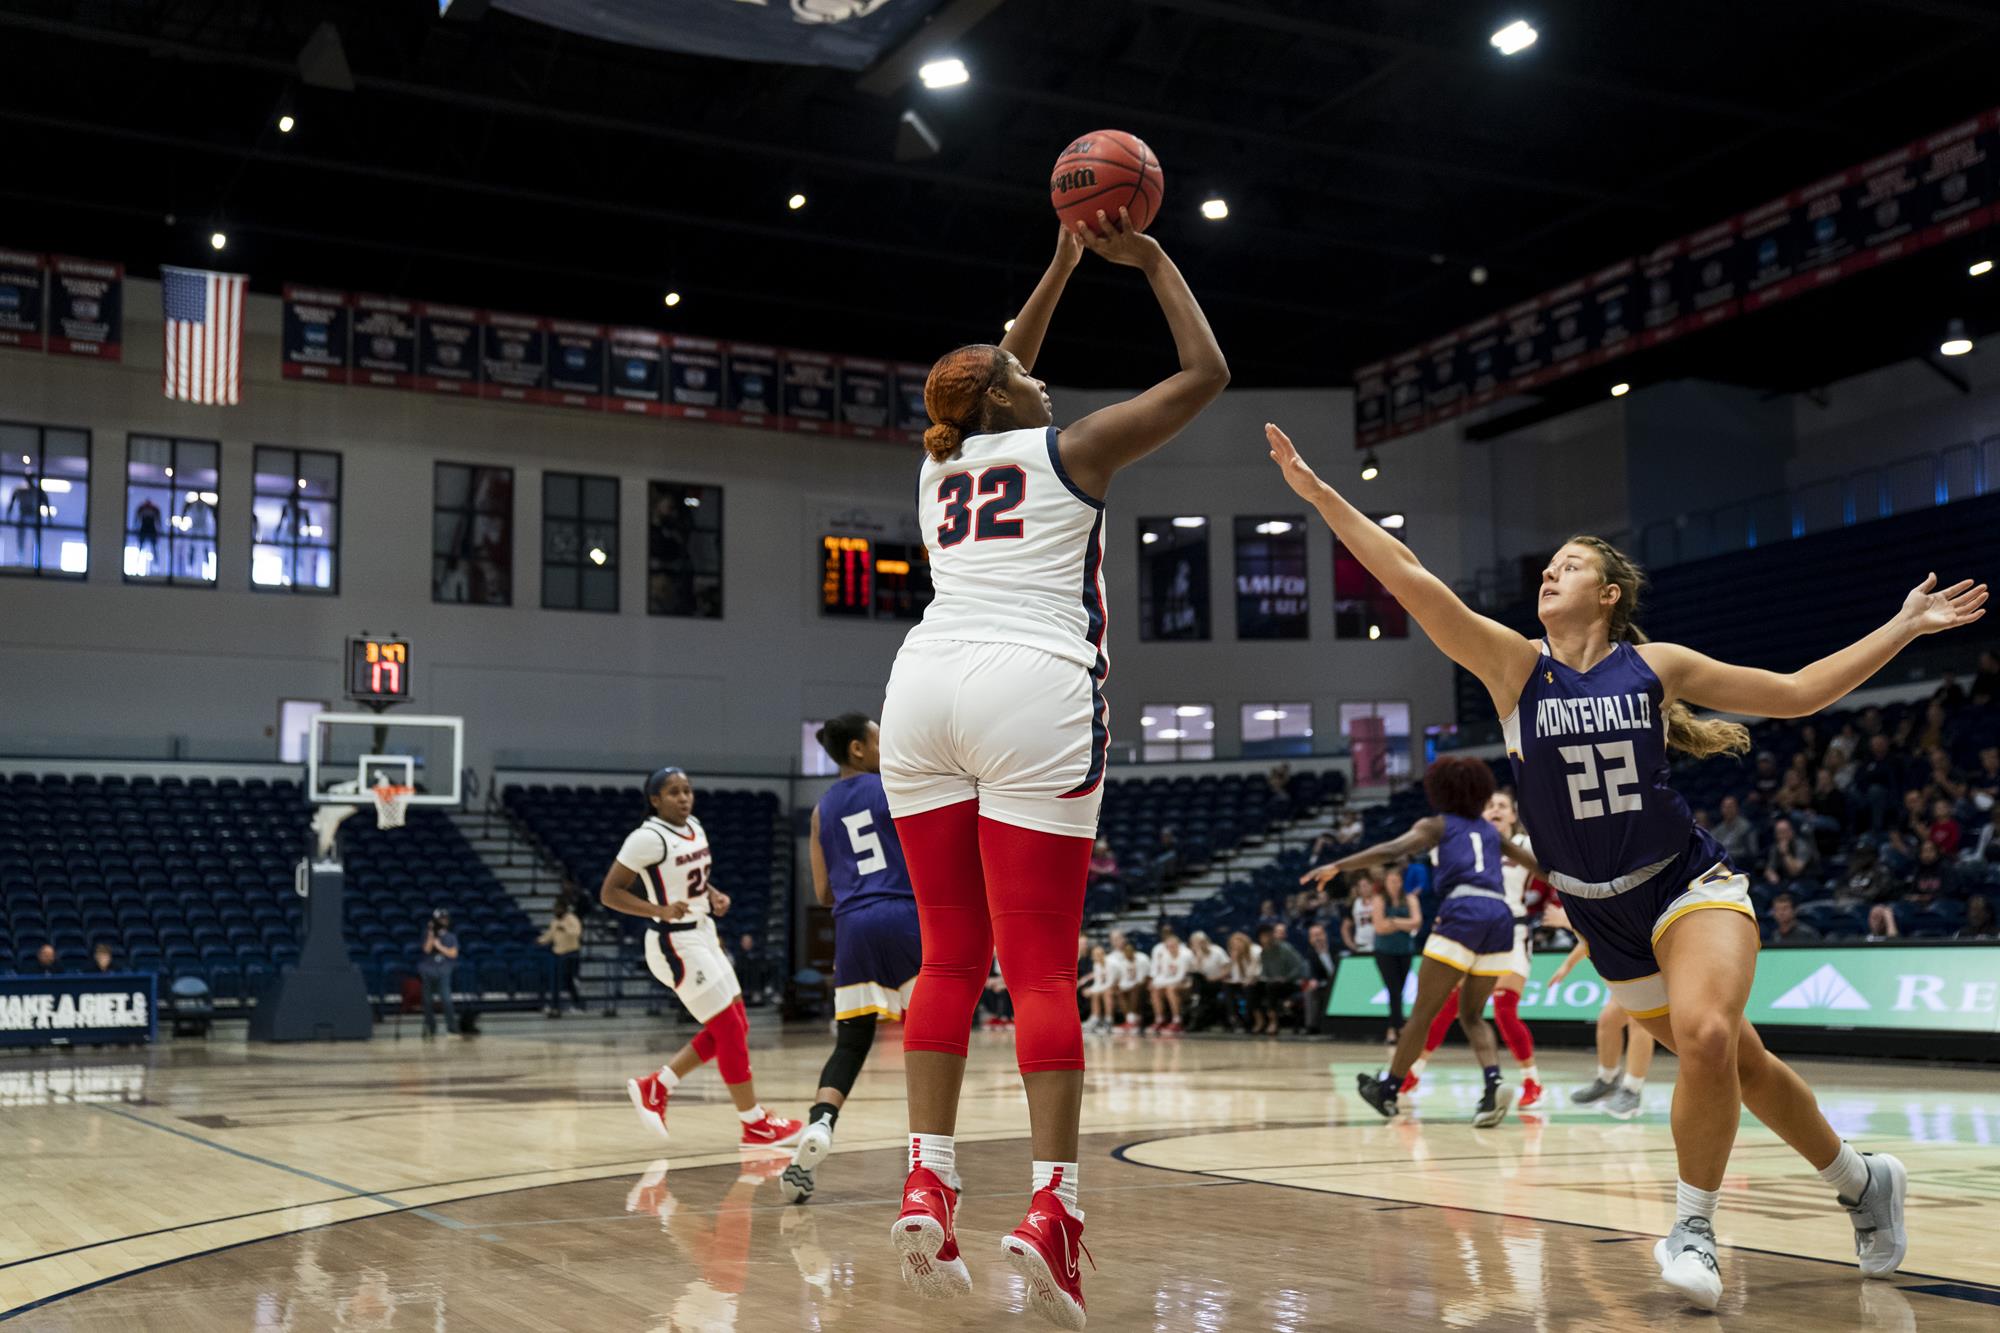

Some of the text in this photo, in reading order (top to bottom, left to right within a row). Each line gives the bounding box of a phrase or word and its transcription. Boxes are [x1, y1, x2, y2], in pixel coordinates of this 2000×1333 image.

[937, 464, 1026, 550] 32
[372, 661, 399, 693] 17
[1536, 693, 1651, 738] MONTEVALLO
[1558, 740, 1643, 820] 22
[841, 808, 887, 876] 5
[1469, 831, 1485, 873] 1
